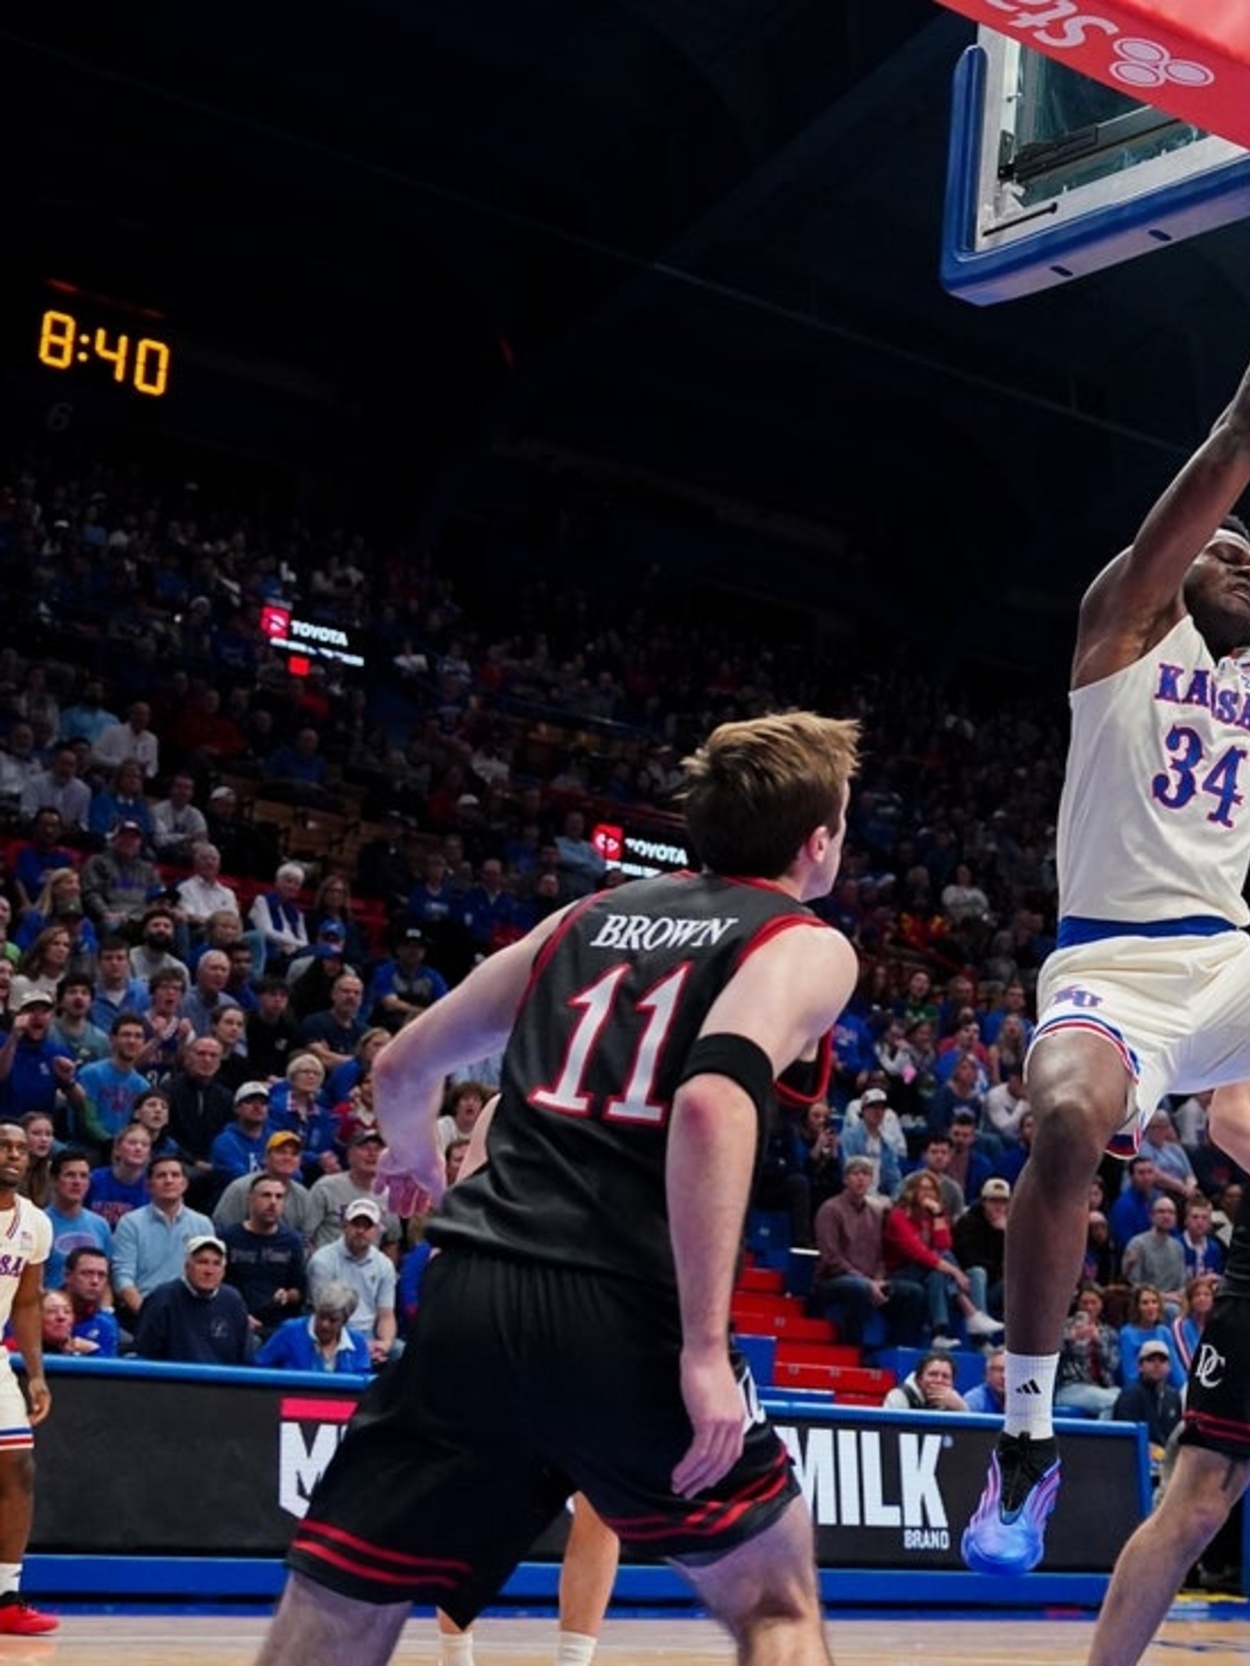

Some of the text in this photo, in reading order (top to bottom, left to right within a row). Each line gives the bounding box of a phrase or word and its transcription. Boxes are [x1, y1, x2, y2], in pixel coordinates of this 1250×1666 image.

[38, 309, 170, 397] 8:40
[290, 619, 349, 648] TOYOTA
[1153, 724, 1248, 828] 34
[624, 837, 689, 866] TOYOTA
[590, 914, 739, 950] BROWN
[527, 960, 694, 1127] 11
[904, 1529, 949, 1550] BRAND
